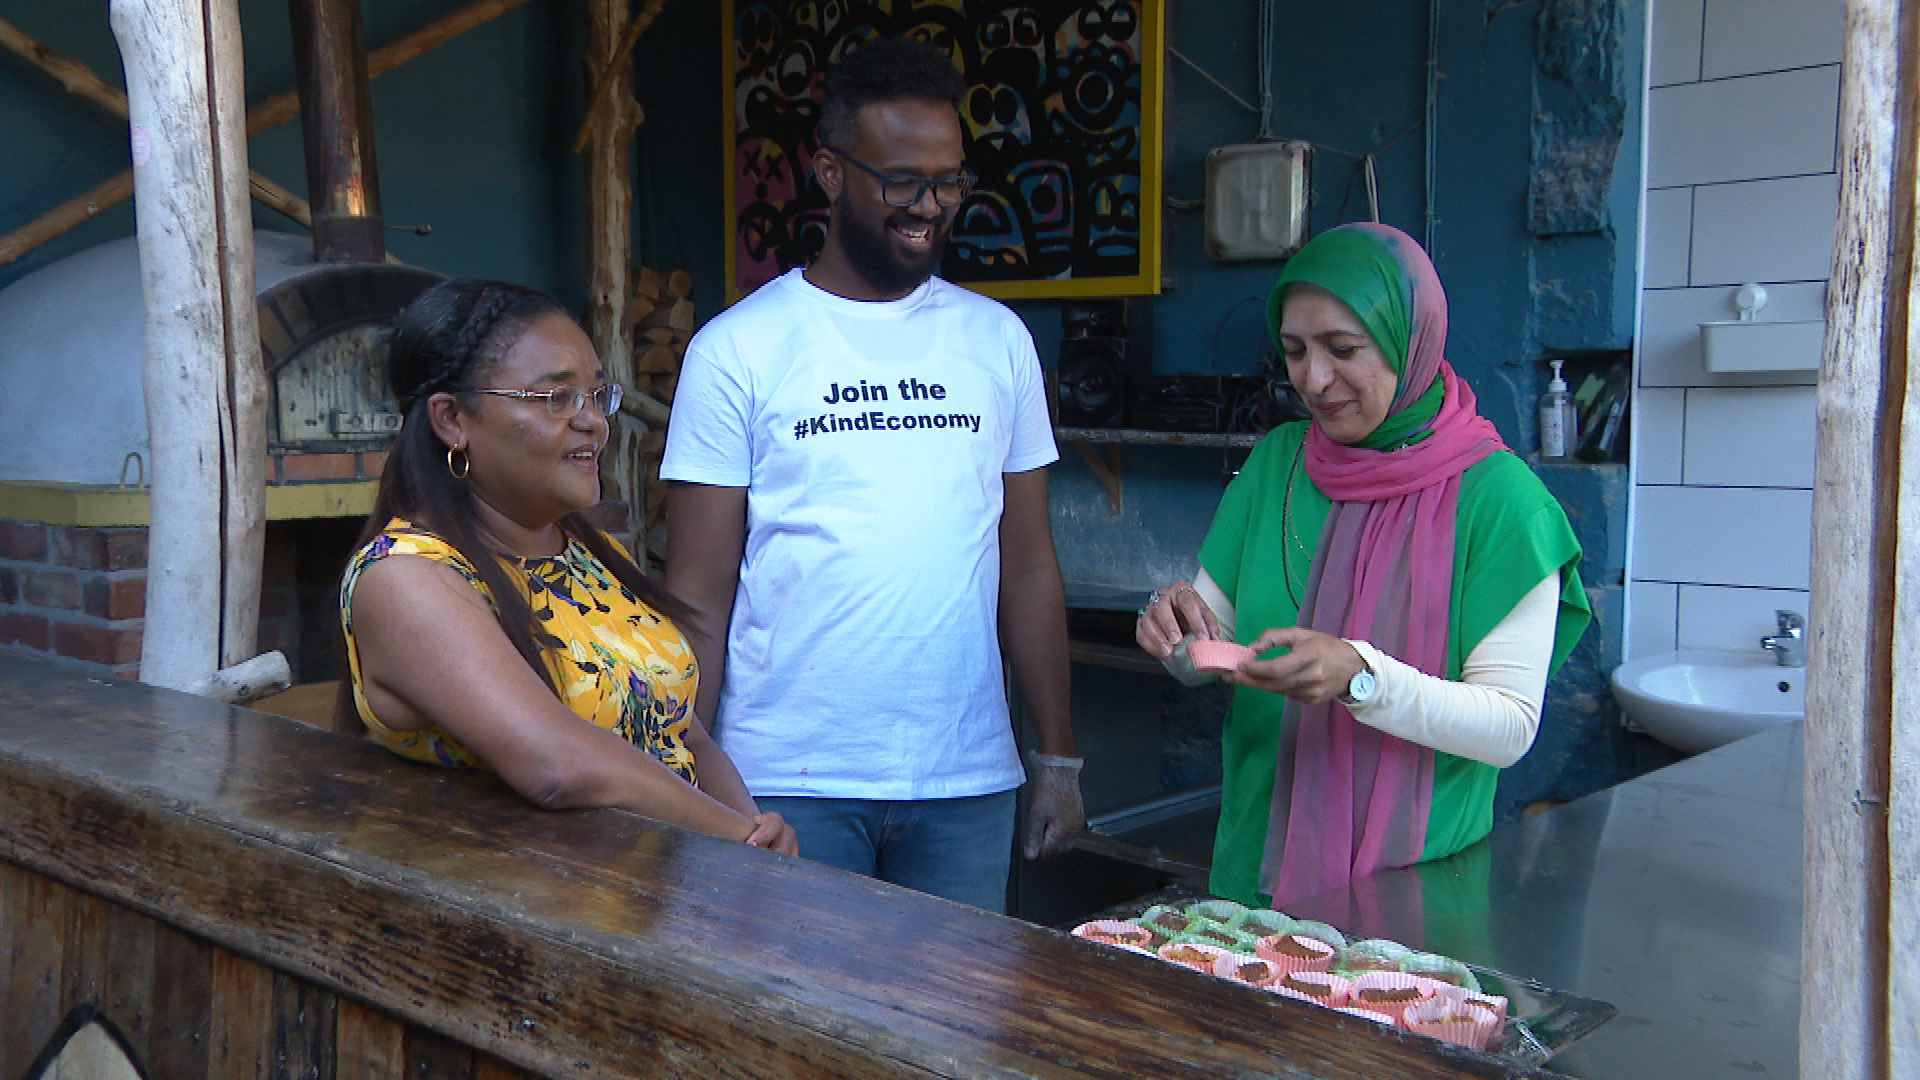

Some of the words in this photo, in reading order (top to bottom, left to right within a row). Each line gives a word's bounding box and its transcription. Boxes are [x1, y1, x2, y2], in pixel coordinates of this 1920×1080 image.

[823, 379, 888, 404] Join
[898, 377, 946, 401] the
[793, 411, 981, 441] #KindEconomy
